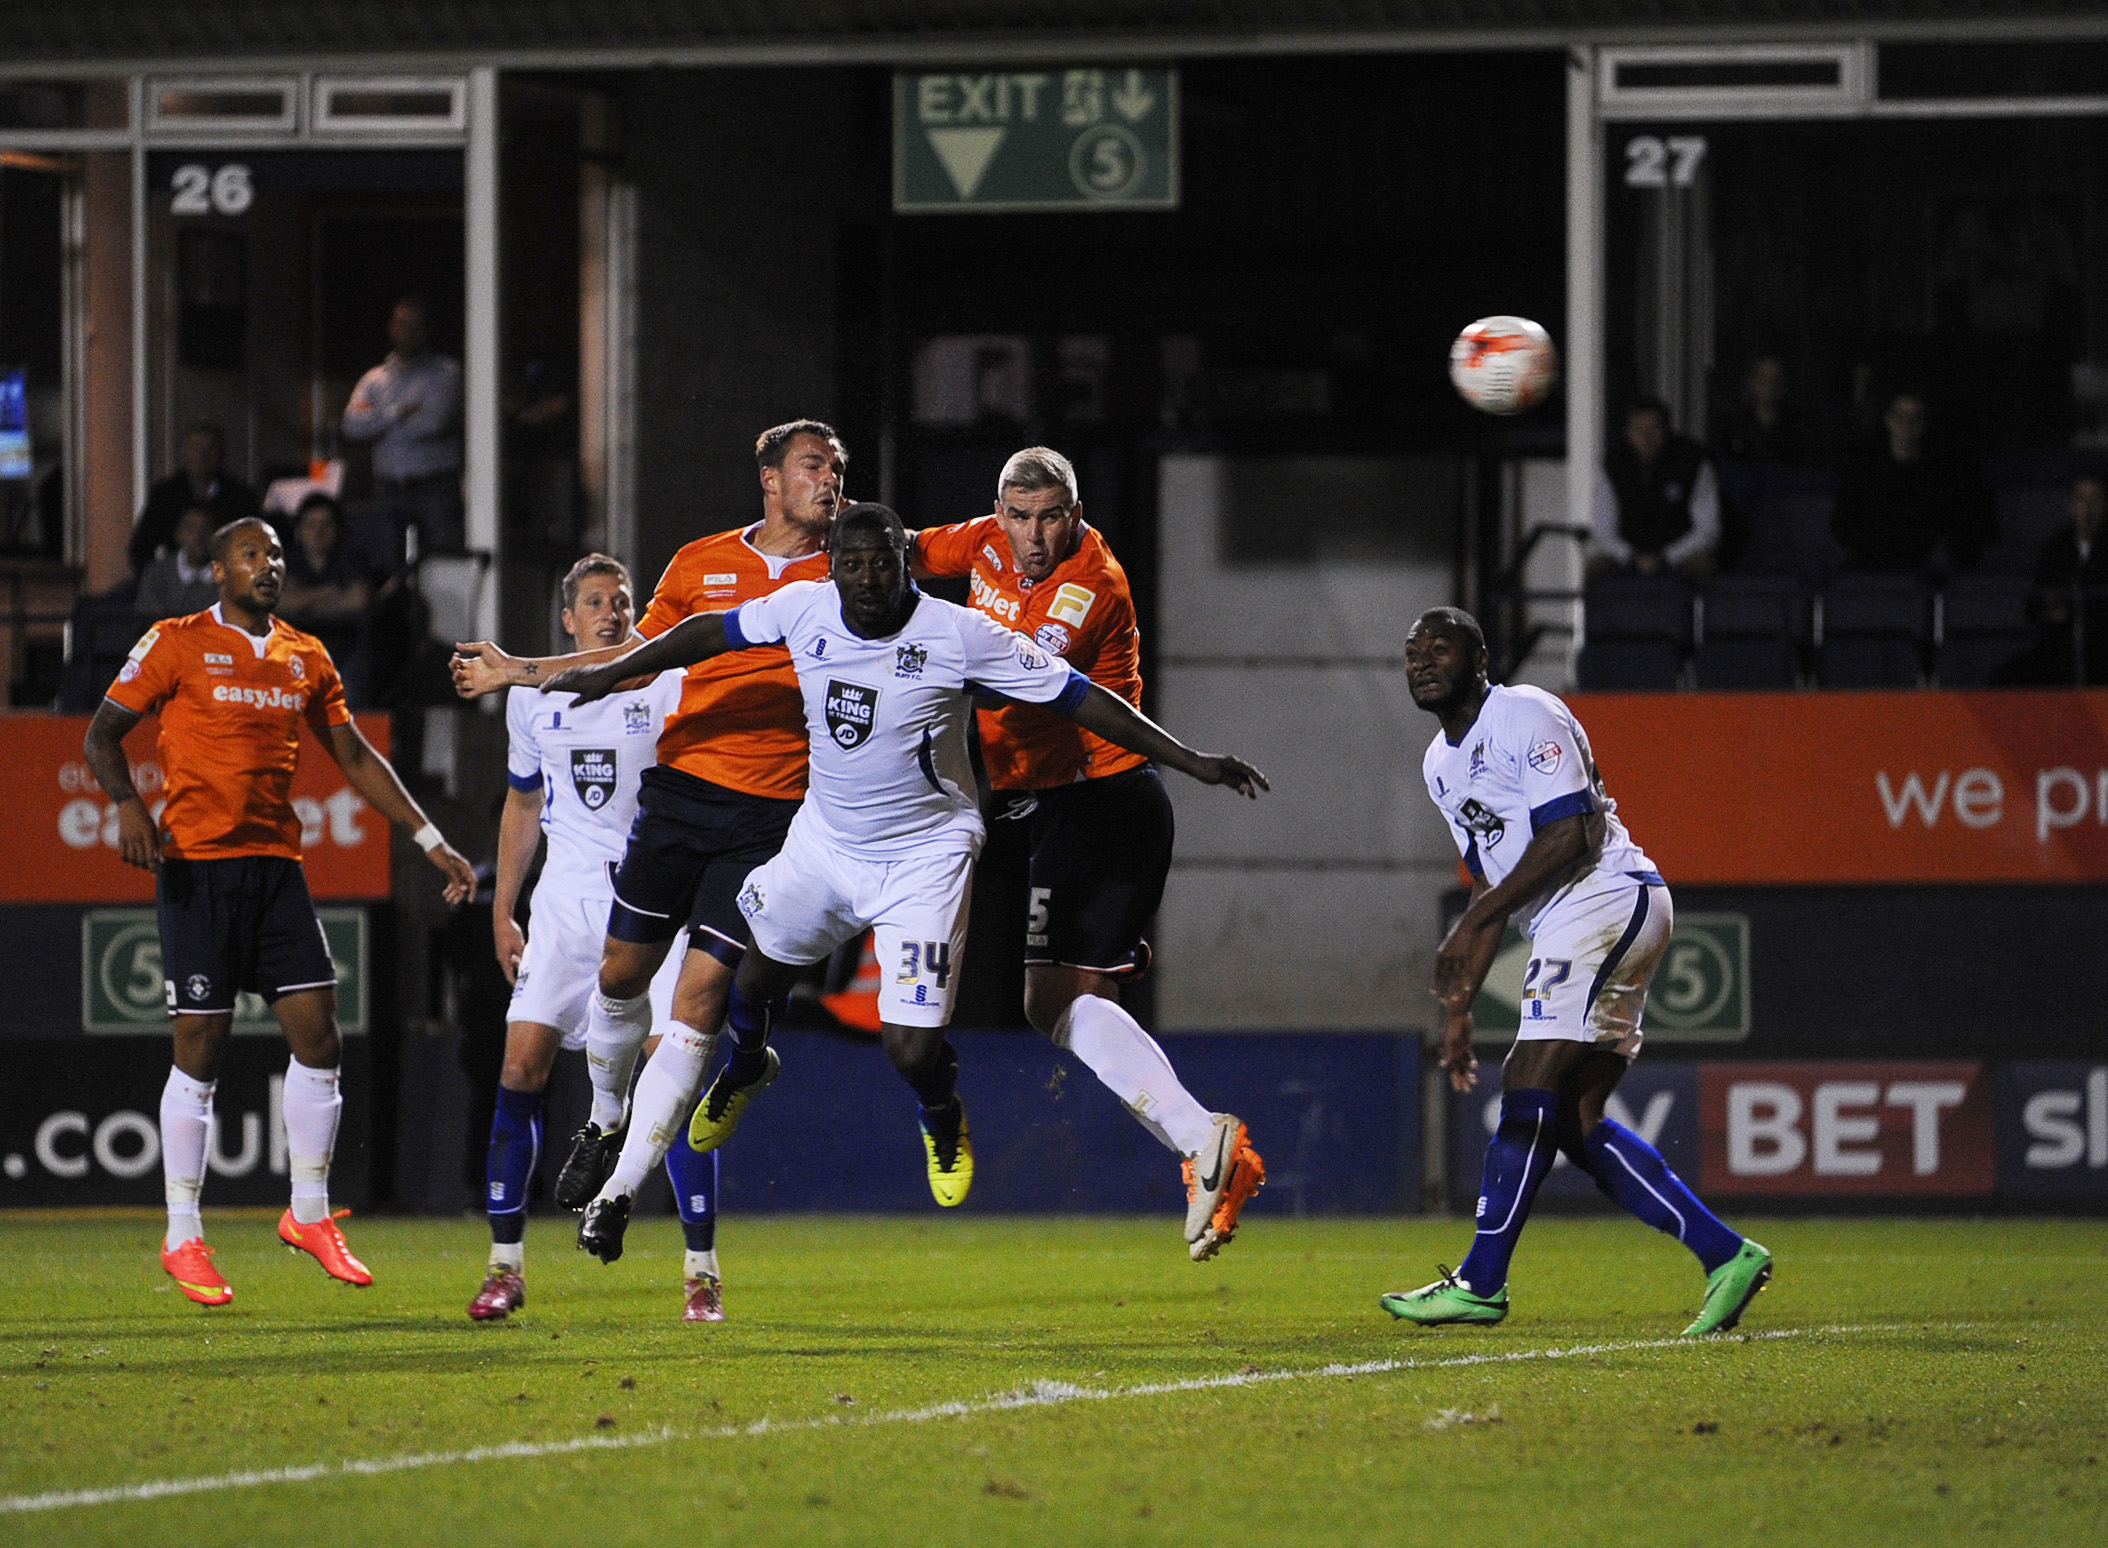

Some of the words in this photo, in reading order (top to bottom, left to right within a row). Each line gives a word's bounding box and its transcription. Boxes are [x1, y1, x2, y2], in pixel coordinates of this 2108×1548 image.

[917, 73, 1049, 123] EXIT
[1623, 135, 1708, 187] 27
[170, 163, 255, 216] 26
[213, 685, 304, 711] easyJet
[828, 696, 871, 719] KING
[839, 729, 855, 740] JD
[573, 763, 614, 777] KING
[1875, 768, 2004, 829] we
[1028, 886, 1052, 933] 5
[126, 941, 165, 1005] 5
[896, 940, 952, 989] 34
[1522, 957, 1573, 1001] 27
[1663, 950, 1705, 1009] 5
[1727, 1082, 1968, 1177] BET
